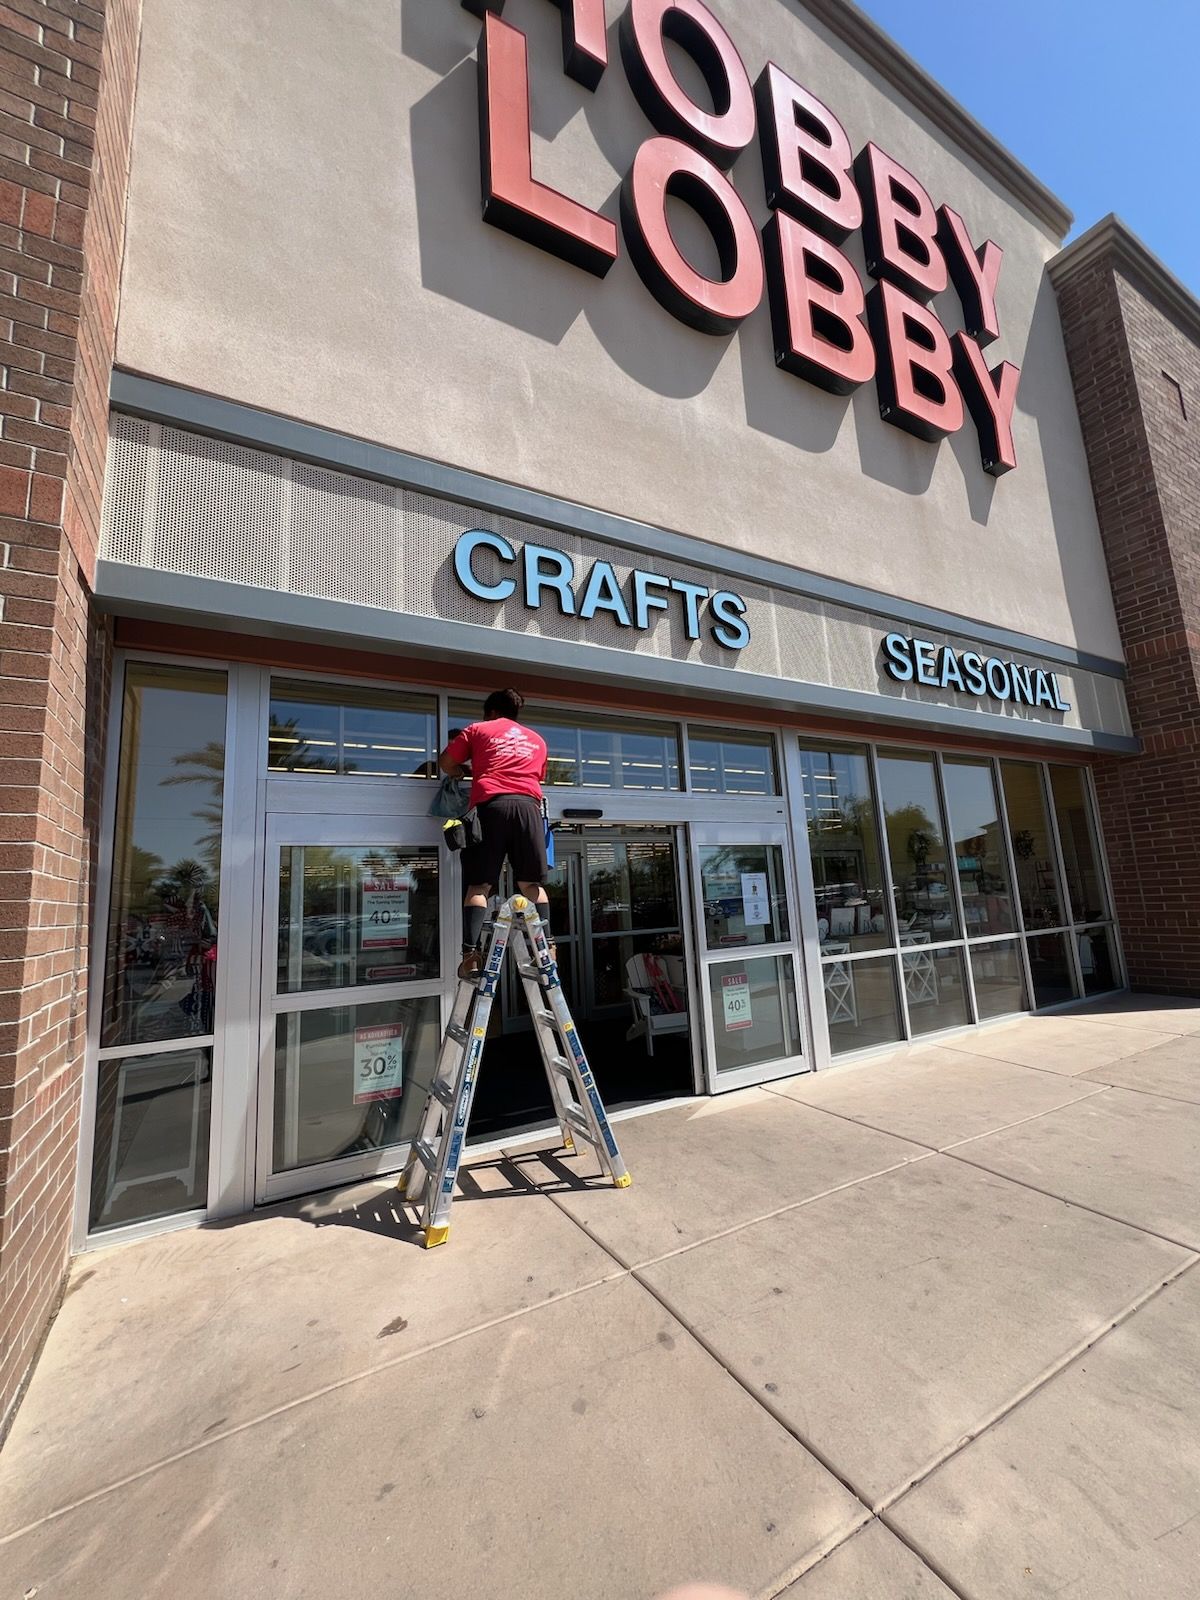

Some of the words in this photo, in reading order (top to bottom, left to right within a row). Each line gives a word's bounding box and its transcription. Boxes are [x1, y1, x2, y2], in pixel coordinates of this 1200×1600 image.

[463, 0, 1003, 348] OBBY
[477, 10, 1020, 476] LOBBY
[454, 528, 750, 650] CRAFTS
[881, 632, 1071, 712] SEASONAL
[374, 881, 399, 891] SALE
[727, 976, 742, 985] SALE
